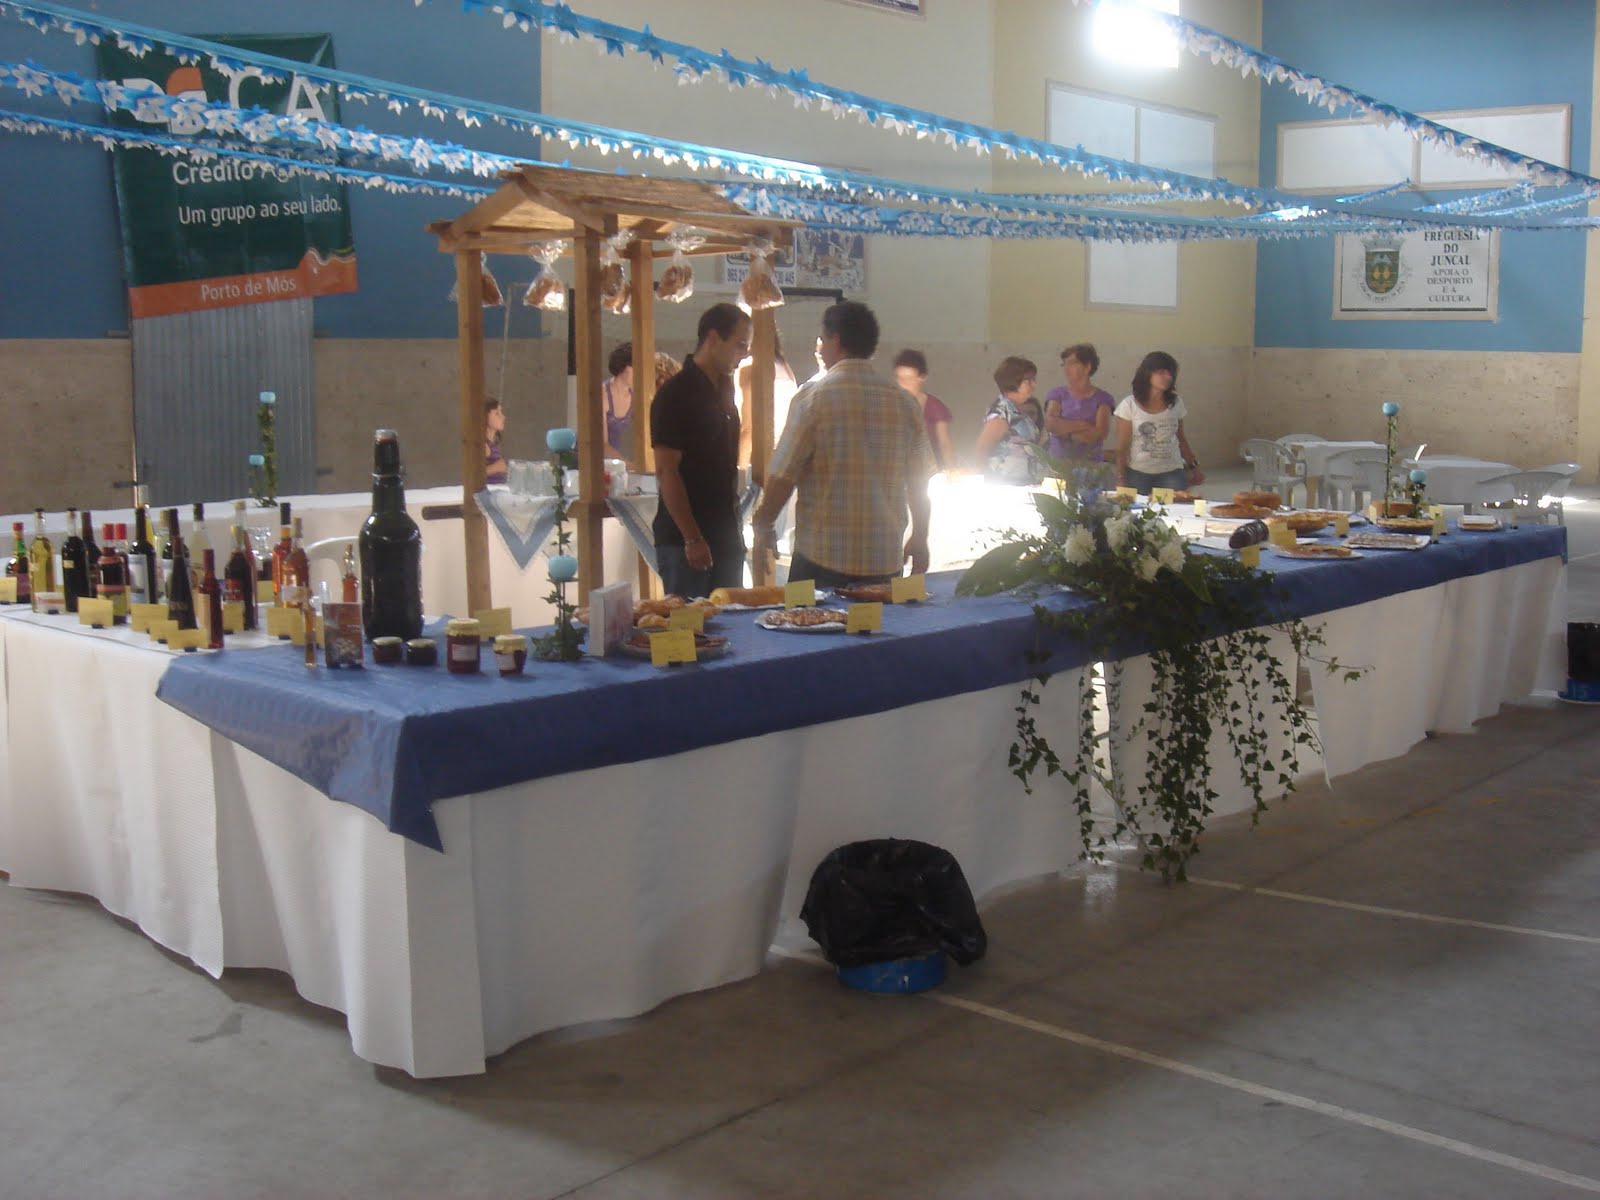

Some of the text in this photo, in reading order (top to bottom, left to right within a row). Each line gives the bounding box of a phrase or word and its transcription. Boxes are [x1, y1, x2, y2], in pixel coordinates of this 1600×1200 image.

[178, 194, 342, 227] Um grupo ao seu lado.
[1424, 230, 1480, 241] FREGUESIA
[1443, 243, 1459, 253] DO
[1430, 255, 1471, 266] JUNCAL
[1427, 277, 1473, 285] DESPORTO
[201, 275, 297, 301] Porto de Mós
